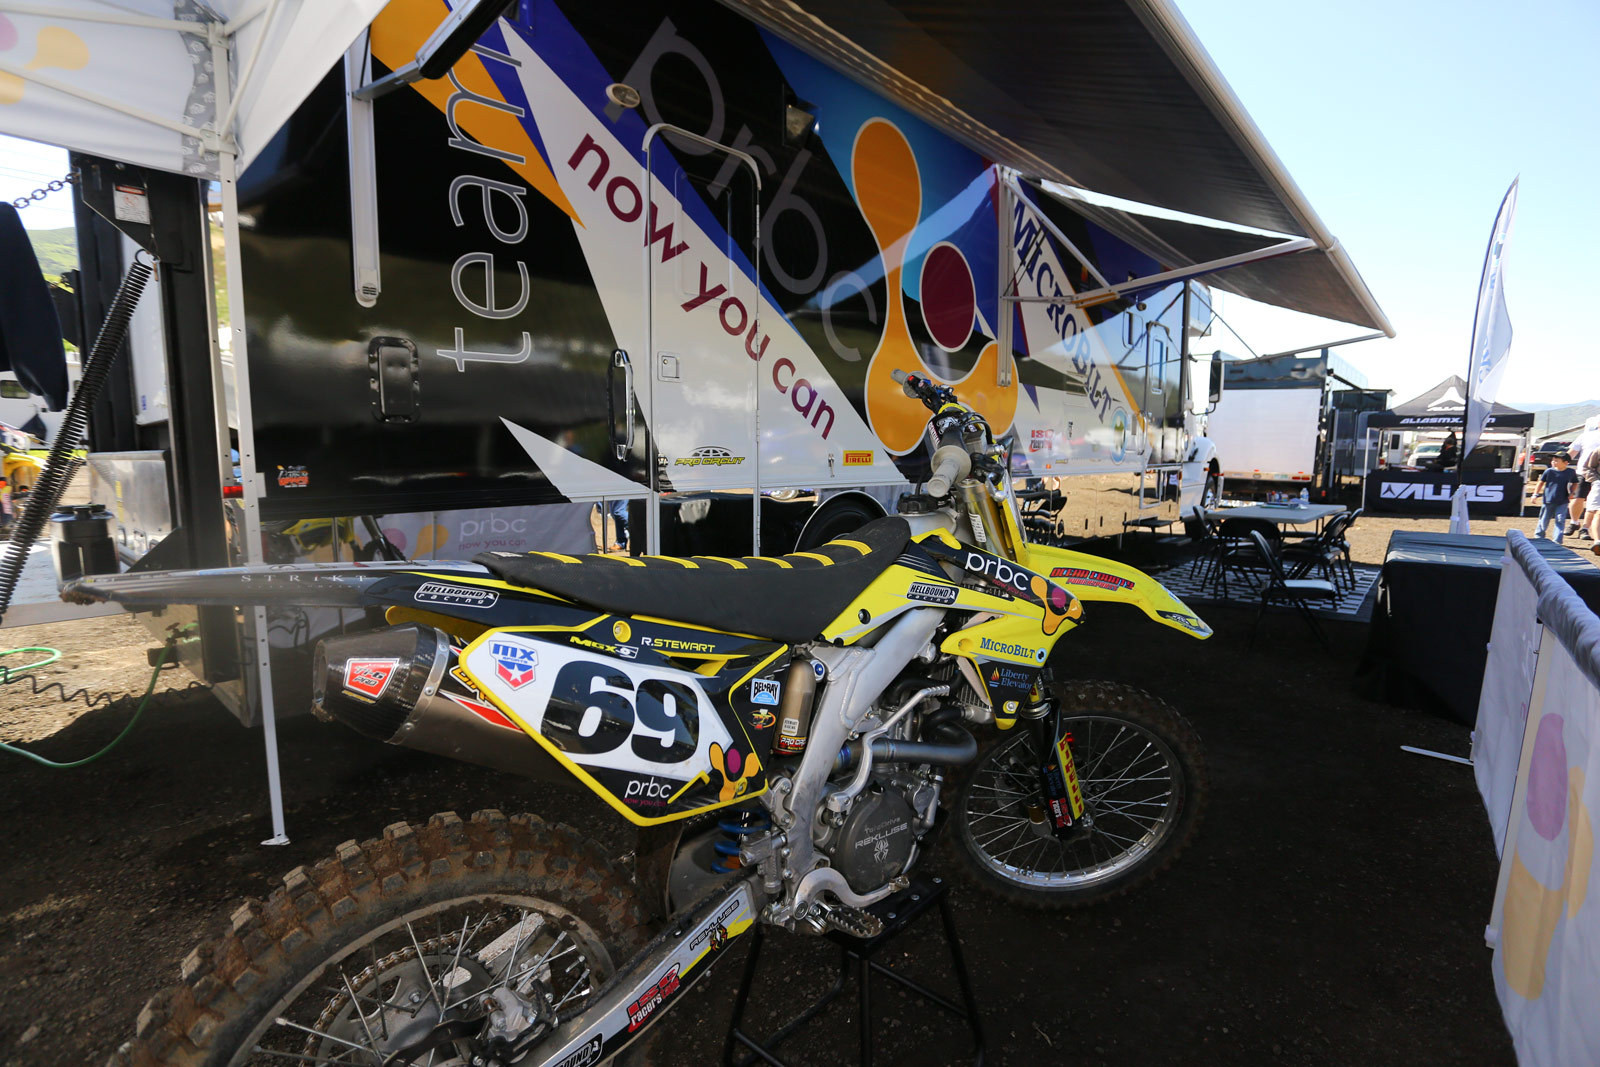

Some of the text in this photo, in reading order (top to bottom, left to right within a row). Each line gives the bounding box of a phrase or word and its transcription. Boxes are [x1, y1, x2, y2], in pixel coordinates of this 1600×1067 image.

[603, 16, 877, 362] prbc
[436, 43, 532, 373] team
[567, 133, 836, 440] now you can
[675, 456, 745, 467] PRO CIRCUIT
[846, 453, 872, 463] PIRELLI
[460, 512, 527, 541] prbc
[458, 538, 527, 550] now you can
[965, 552, 1029, 591] prbc
[422, 585, 484, 597] HELLBOUND
[910, 585, 949, 597] HELLBOUND
[352, 675, 379, 687] PRO
[1000, 668, 1030, 680] Liberty
[1001, 678, 1032, 690] Elevator
[540, 660, 700, 764] 69
[624, 776, 672, 798] prbc
[855, 822, 908, 849] REKLUSE
[690, 900, 740, 951] REKLUSE
